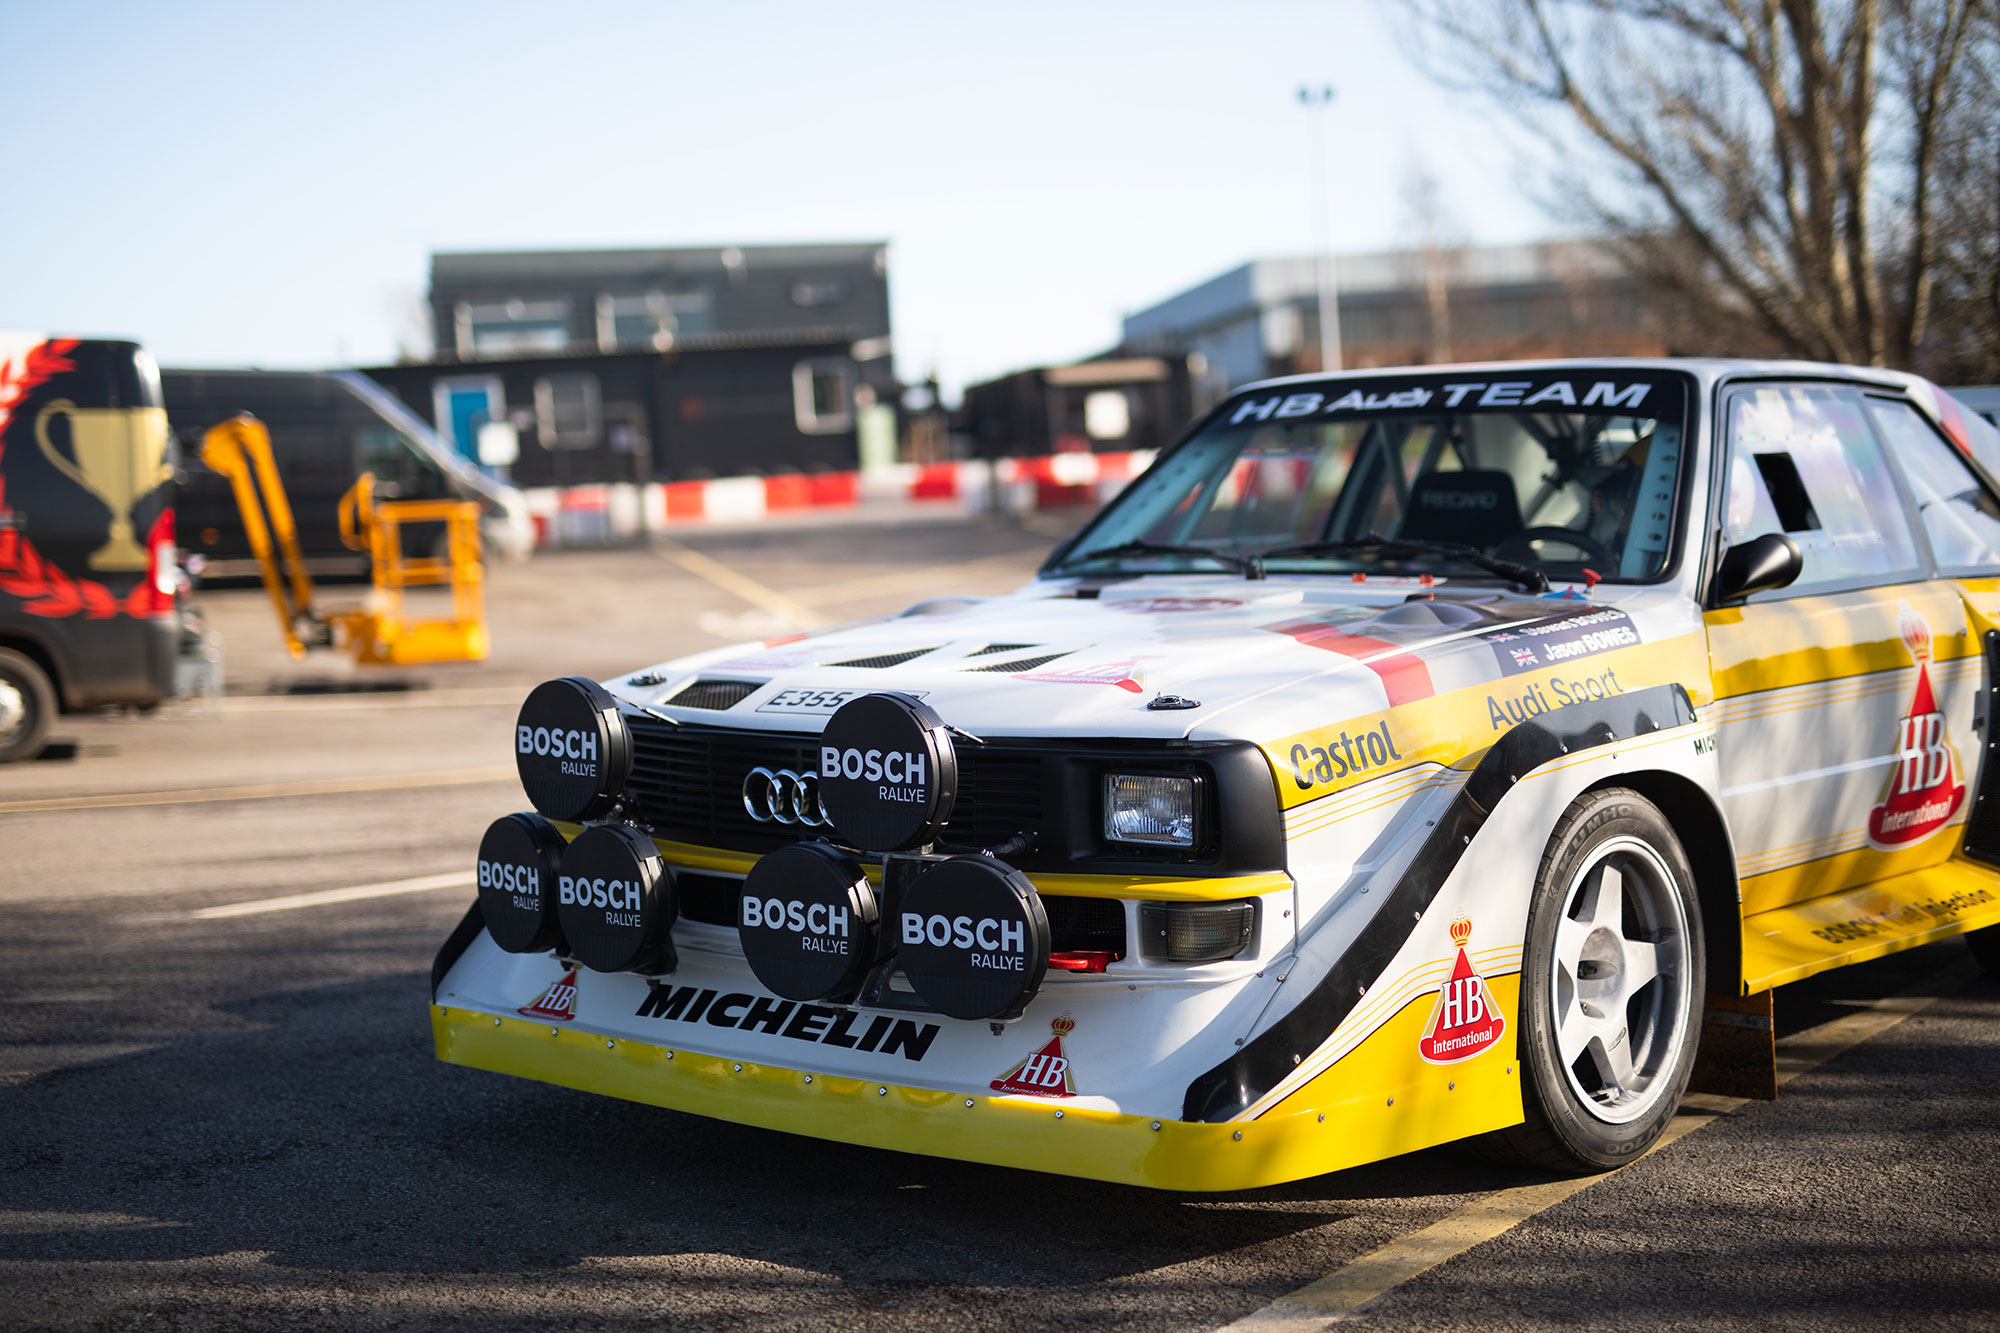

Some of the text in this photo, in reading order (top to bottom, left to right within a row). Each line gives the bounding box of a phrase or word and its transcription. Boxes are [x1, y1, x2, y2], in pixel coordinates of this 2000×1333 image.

[1230, 381, 1652, 425] HB Audi TEAM
[1422, 491, 1497, 509] RECARO
[1573, 608, 1627, 629] BOWES
[1543, 626, 1637, 662] Jason BOWES
[767, 690, 854, 707] E355
[1487, 667, 1624, 730] Audi Sport
[518, 725, 597, 761] BOSCH
[1290, 720, 1402, 790] Castrol
[1897, 710, 1950, 795] HB
[561, 761, 597, 777] RALLYE
[821, 746, 926, 785] BOSCH
[879, 785, 926, 803] RALLYE
[1880, 794, 1954, 834] international
[1558, 804, 1633, 875] KUMHO
[479, 860, 540, 896] BOSCH
[559, 876, 641, 911] BOSCH
[513, 895, 540, 911] RALLYE
[605, 911, 642, 927] RALLYE
[743, 895, 849, 937] BOSCH
[802, 937, 849, 955] RALLYE
[902, 912, 1025, 953] BOSCH
[971, 953, 1025, 971] RALLYE
[538, 982, 578, 1011] HB
[1442, 975, 1484, 1030] HB
[635, 984, 942, 1061] MICHELIN
[1433, 1026, 1493, 1054] international
[1016, 1053, 1069, 1088] HB
[1001, 1083, 1063, 1098] international
